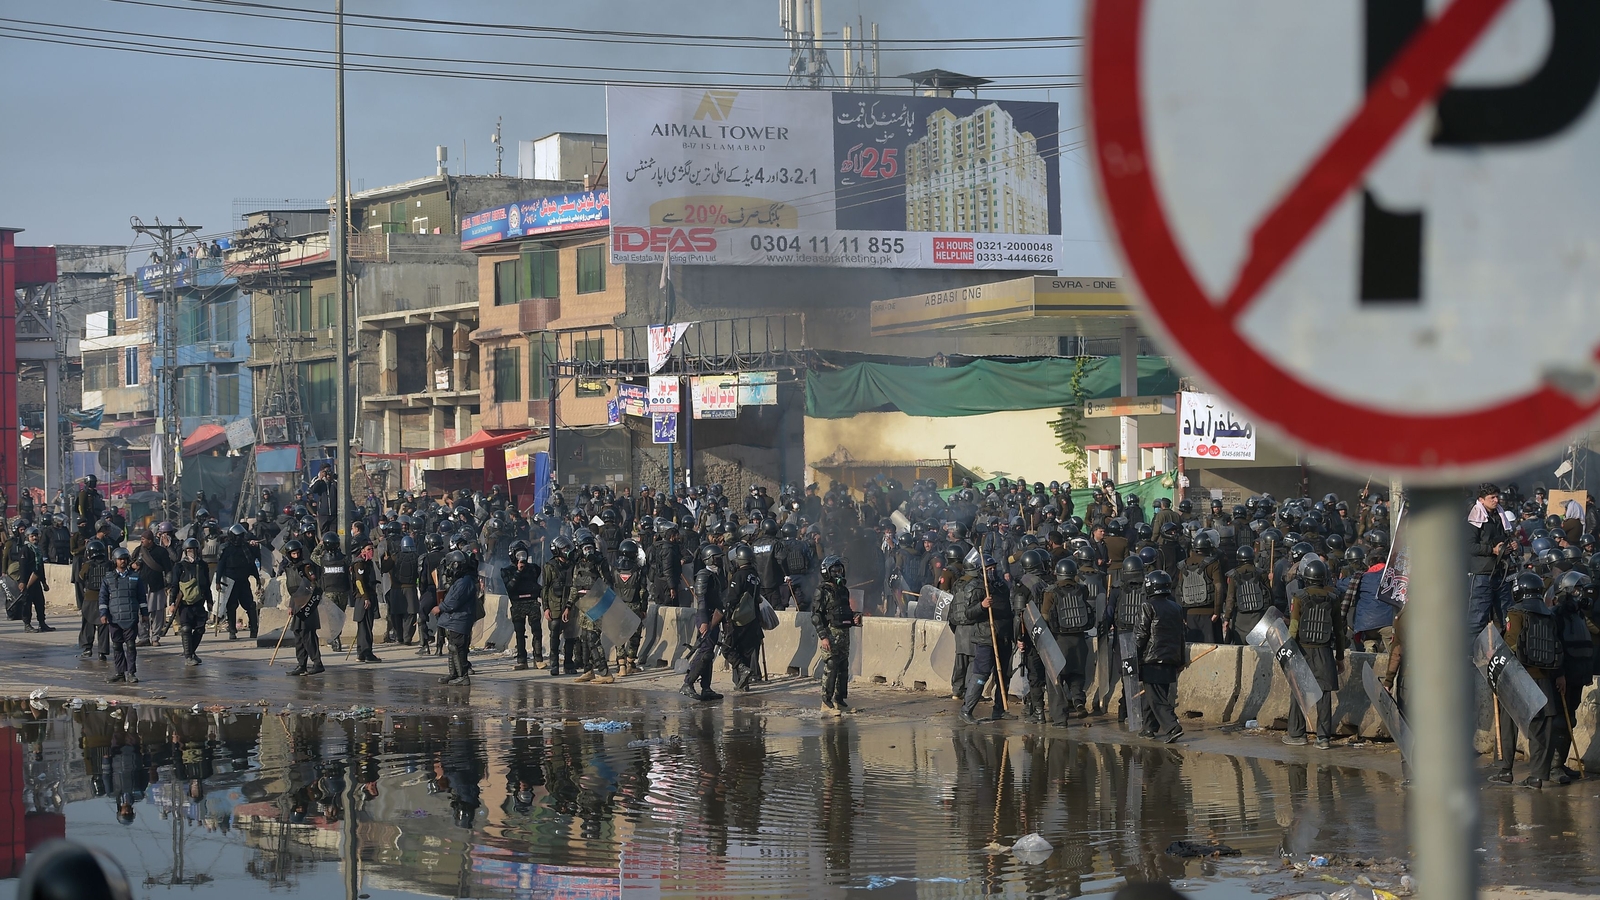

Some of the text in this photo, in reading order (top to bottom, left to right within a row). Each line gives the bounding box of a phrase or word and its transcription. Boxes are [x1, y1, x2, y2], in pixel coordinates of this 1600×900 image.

[651, 123, 789, 140] AIMAL TOWER
[861, 147, 898, 178] 25
[754, 168, 765, 183] 4
[684, 204, 728, 225] 20%
[613, 227, 717, 252] IDEAS
[750, 234, 905, 254] 0304 11 11 855
[936, 241, 1053, 252] 24 HOURS 0321-2000048
[655, 254, 687, 264] Maeting
[766, 253, 892, 265] www.ideasmarketing.pk
[936, 251, 1054, 263] HELPLINE 0333-4446626
[1052, 281, 1083, 289] SVRA
[1093, 281, 1117, 289] ONE
[924, 287, 982, 307] ABBASI CNG
[753, 544, 772, 553] POLICE
[304, 594, 321, 617] POLICE
[935, 596, 951, 621] OLICE
